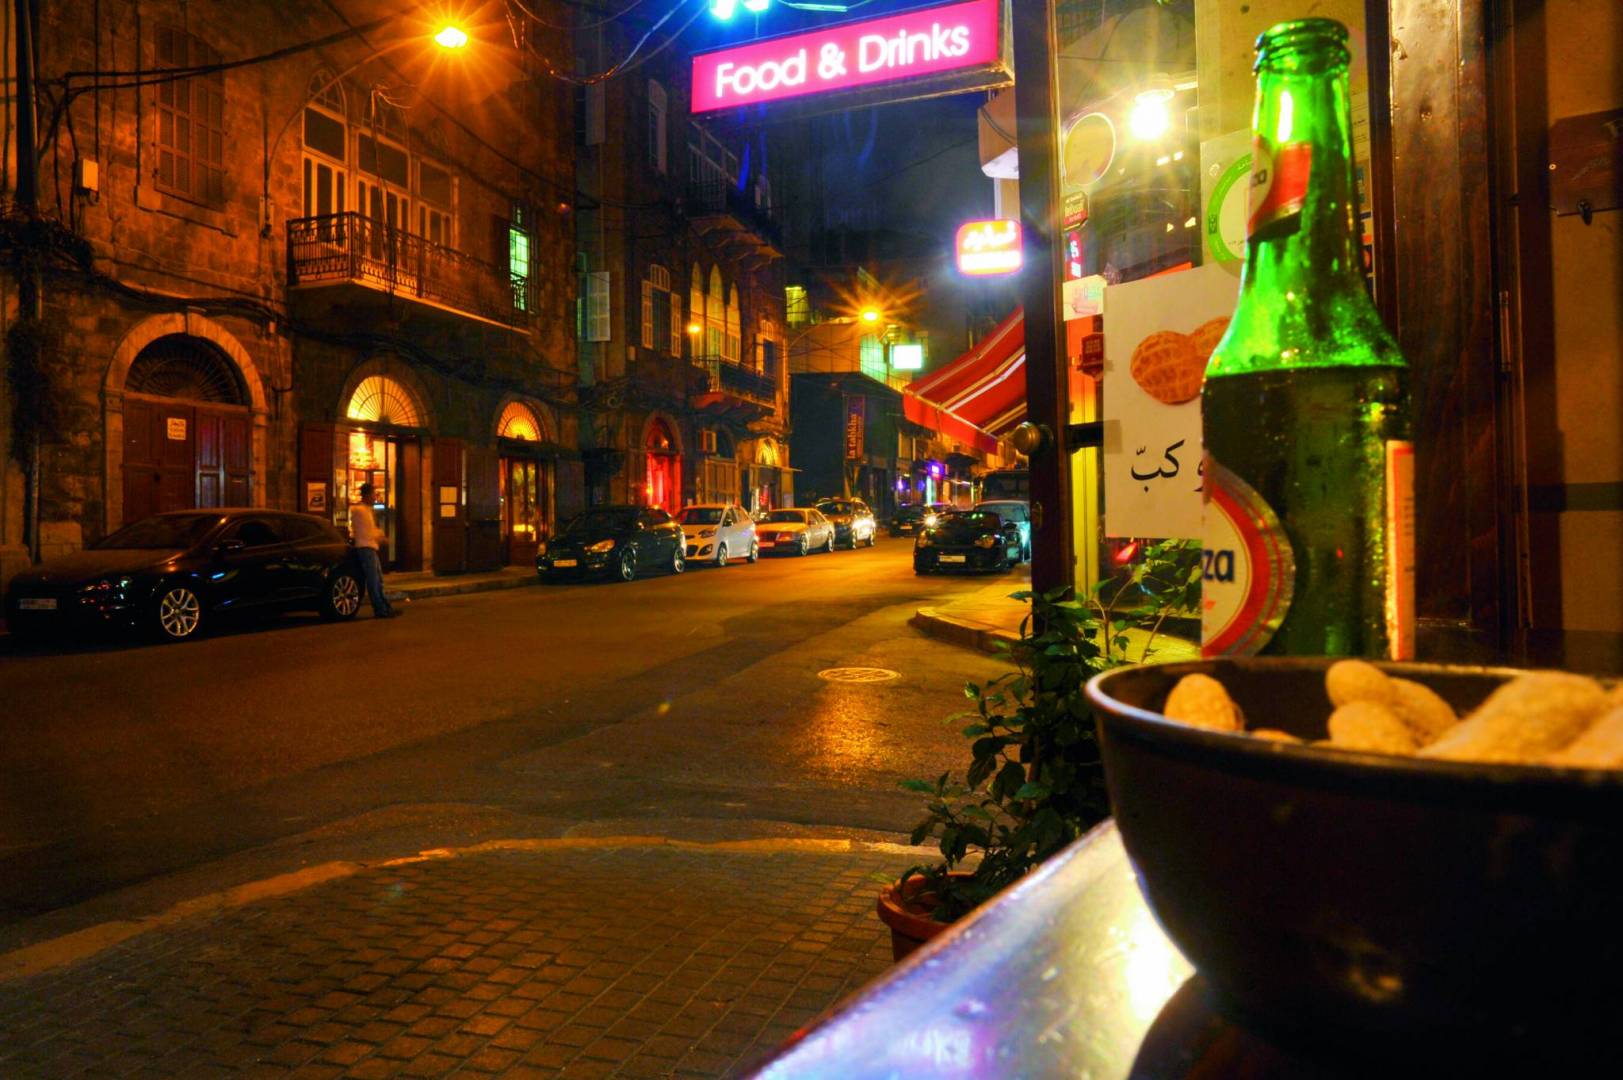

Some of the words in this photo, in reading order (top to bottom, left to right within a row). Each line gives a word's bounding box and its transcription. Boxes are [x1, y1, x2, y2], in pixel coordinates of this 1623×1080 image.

[715, 48, 806, 98] Food
[817, 42, 847, 80] &
[858, 22, 970, 73] Drinks
